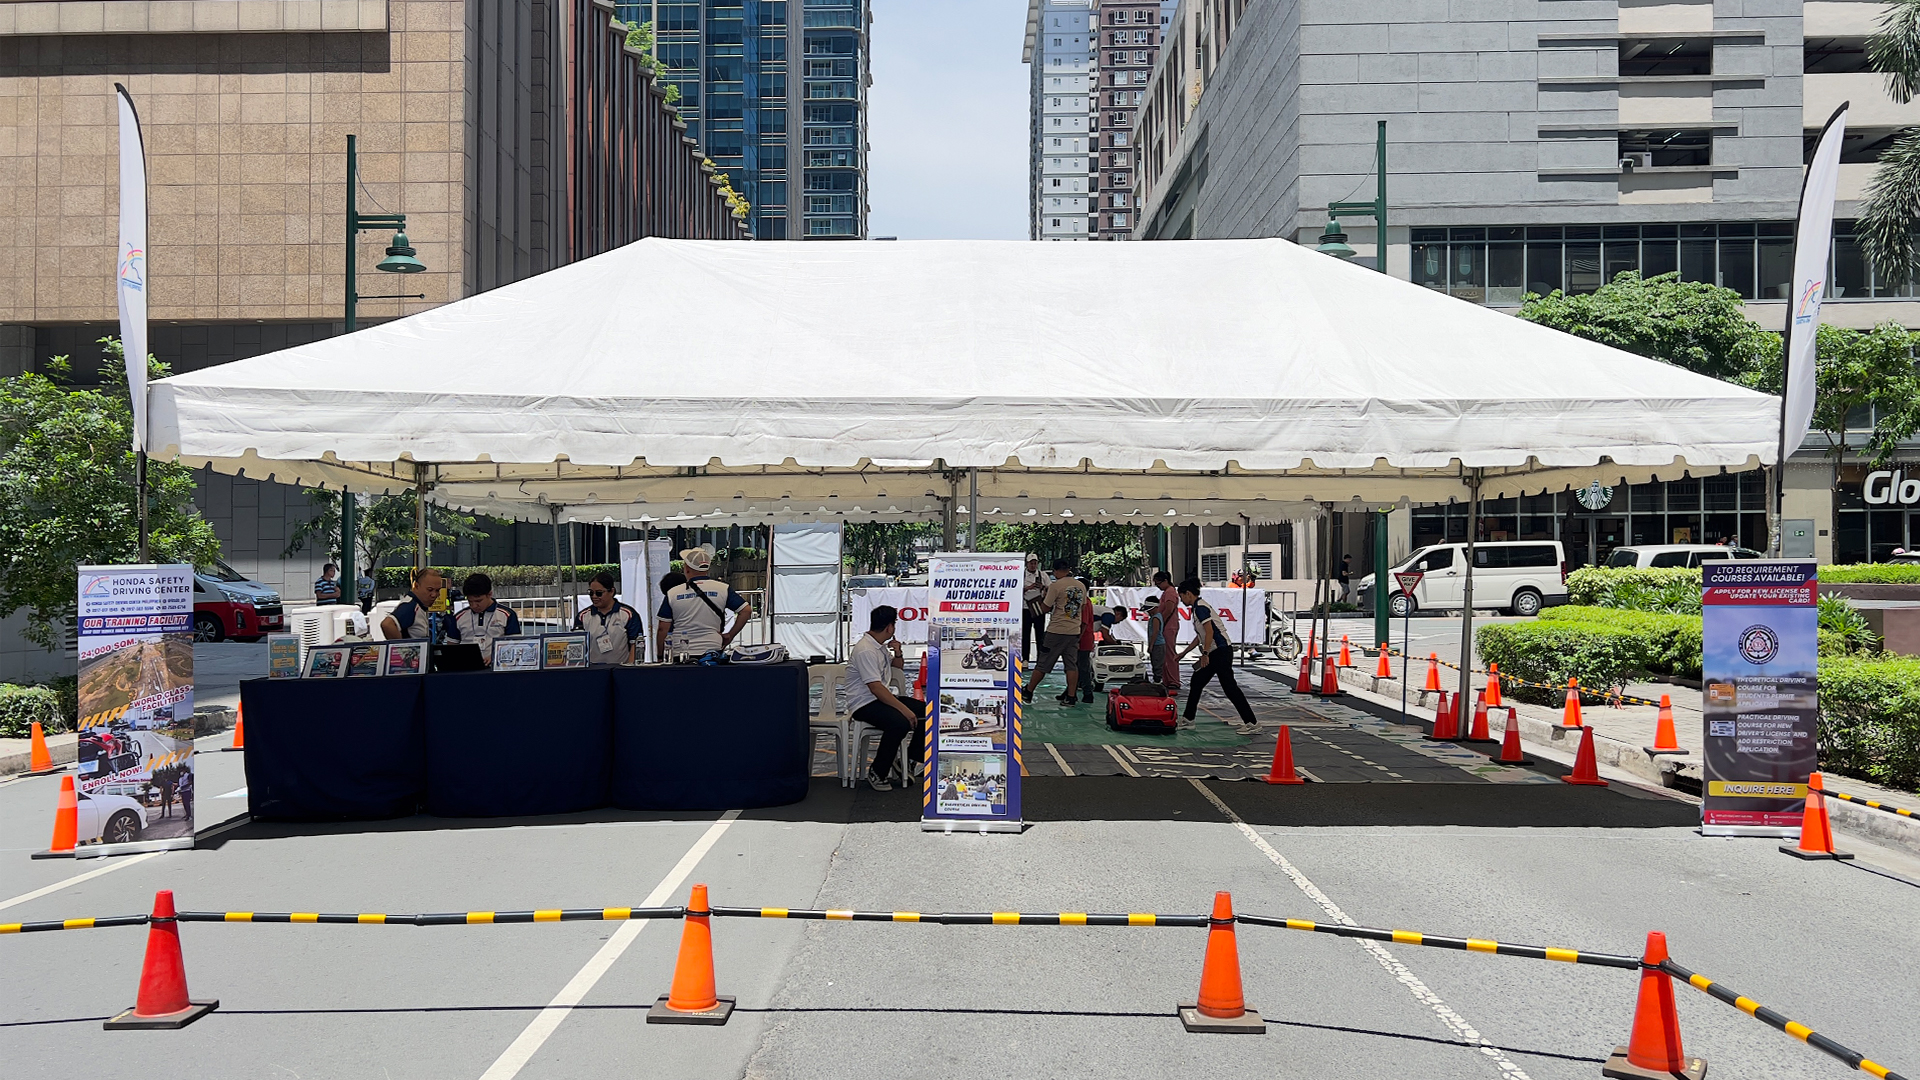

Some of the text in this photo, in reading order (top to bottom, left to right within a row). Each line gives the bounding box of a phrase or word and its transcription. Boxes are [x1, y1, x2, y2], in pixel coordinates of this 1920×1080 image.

[1863, 470, 1920, 504] Glo
[1717, 566, 1799, 574] LTO REQUIREMENT
[112, 576, 185, 586] HONDA SAFETY
[934, 578, 1018, 588] MOTORCYCLE AND
[1711, 574, 1805, 583] COURSES AVAILABLE!
[112, 586, 151, 596] DRIVING
[154, 586, 190, 594] CENTER
[946, 590, 1006, 600] AUTOMOBILE
[1129, 607, 1237, 621] HNA
[84, 615, 188, 628] OUR TRAINING FACILITY
[81, 638, 138, 659] 24,000 SQM.
[133, 685, 190, 707] WORLD CLASS
[142, 694, 186, 712] FACILITIES
[82, 766, 143, 791] ENROLL NOW!
[1724, 784, 1795, 795] INQUIRE HERE!
